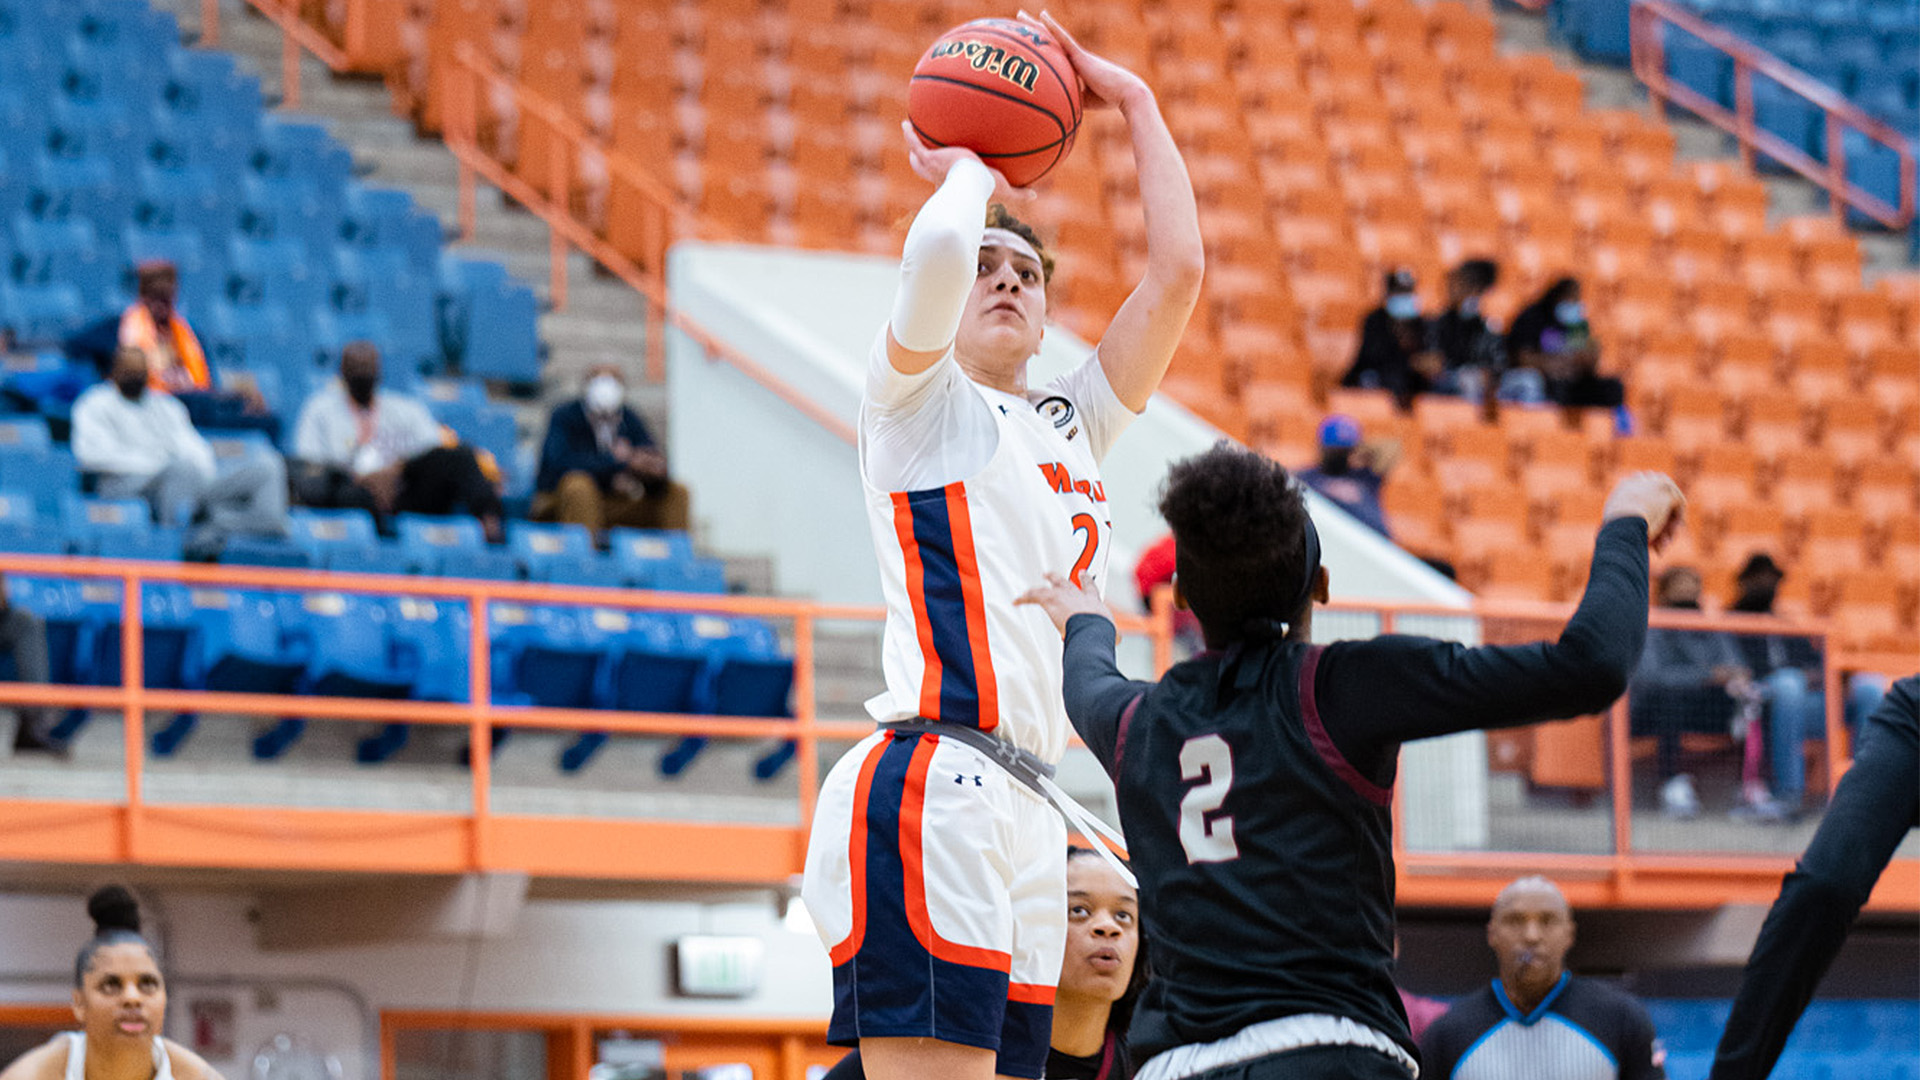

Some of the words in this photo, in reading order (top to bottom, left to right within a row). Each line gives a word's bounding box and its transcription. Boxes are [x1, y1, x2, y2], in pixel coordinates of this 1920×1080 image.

[931, 40, 1040, 94] Wilson
[1068, 512, 1112, 591] 2
[1178, 733, 1240, 865] 2
